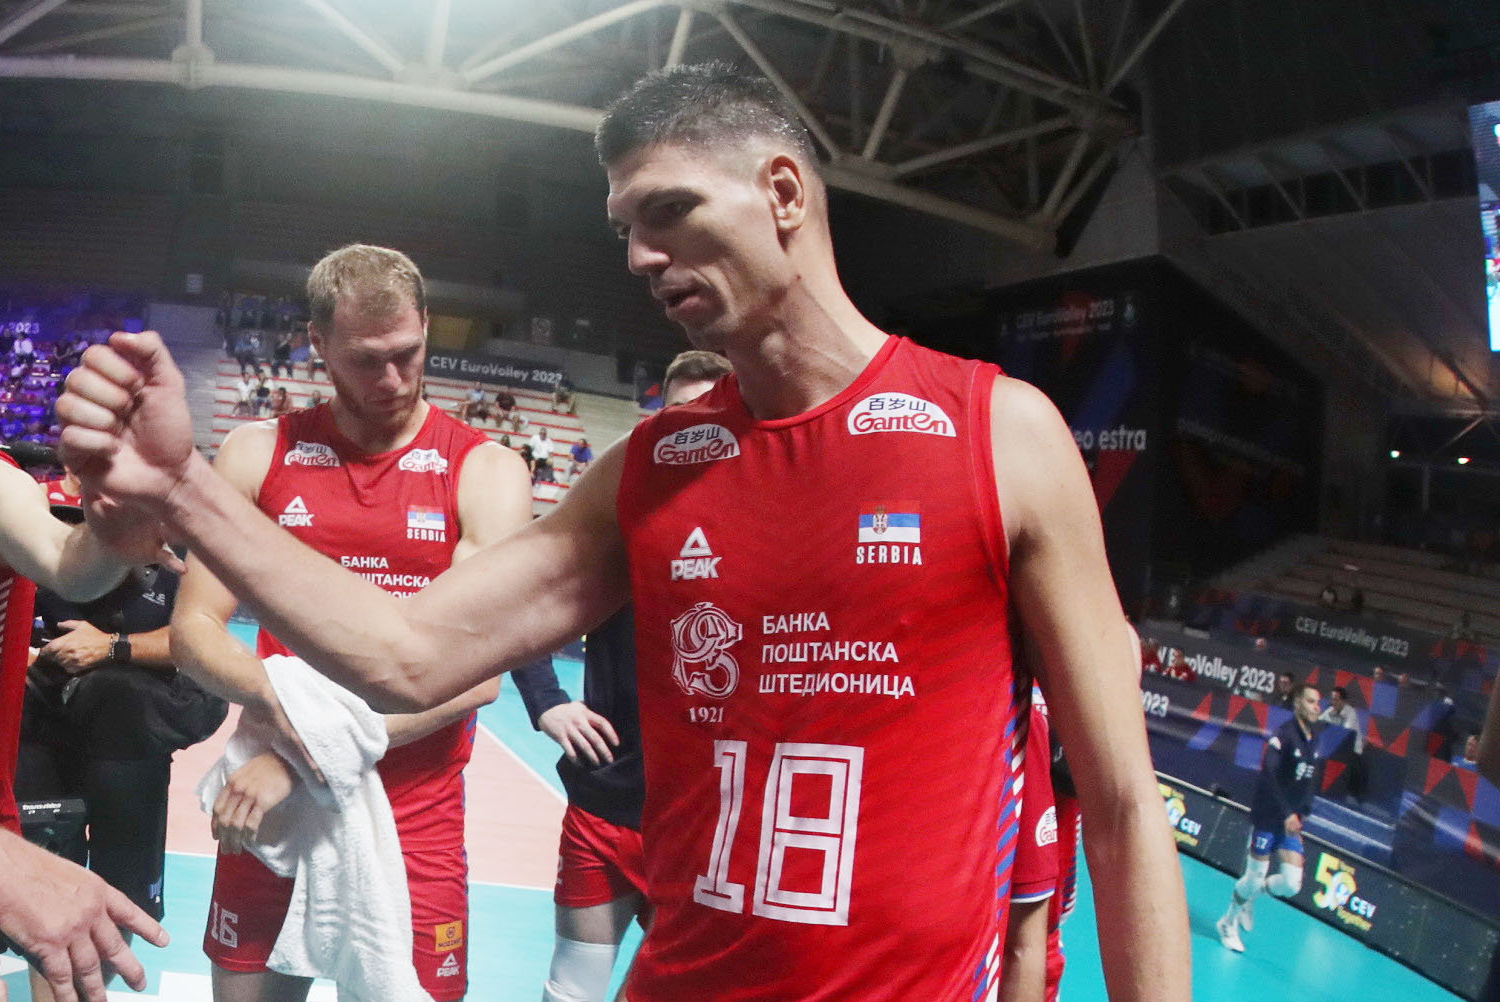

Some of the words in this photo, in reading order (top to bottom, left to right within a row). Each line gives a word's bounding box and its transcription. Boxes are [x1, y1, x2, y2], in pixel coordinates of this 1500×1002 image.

[430, 355, 459, 371] CEV
[460, 359, 529, 381] EuroVolley
[868, 397, 927, 411] 百岁山
[852, 411, 948, 434] Ganten
[674, 426, 721, 445] 百岁山
[1099, 425, 1147, 451] estra
[657, 438, 736, 463] Ganten
[278, 513, 315, 527] PEAK
[406, 528, 446, 543] SERBIA
[340, 555, 389, 569] БАНКА
[855, 545, 923, 566] SERBIA
[670, 556, 722, 580] PEAK
[357, 572, 431, 588] ШТАНСКА
[762, 611, 831, 635] БАНКА
[1294, 616, 1319, 635] CEV
[1320, 621, 1379, 652] EuroVolley
[1379, 635, 1410, 658] 2023
[761, 641, 900, 664] ПОШТАНСКА
[758, 672, 916, 700] ШТЕДИОНИЦА
[1239, 665, 1276, 694] 2023
[687, 706, 725, 724] 1921
[692, 739, 865, 927] 18
[1179, 817, 1202, 836] CEV
[1349, 895, 1377, 919] CEV
[211, 901, 239, 949] 16
[435, 964, 461, 978] PEAK
